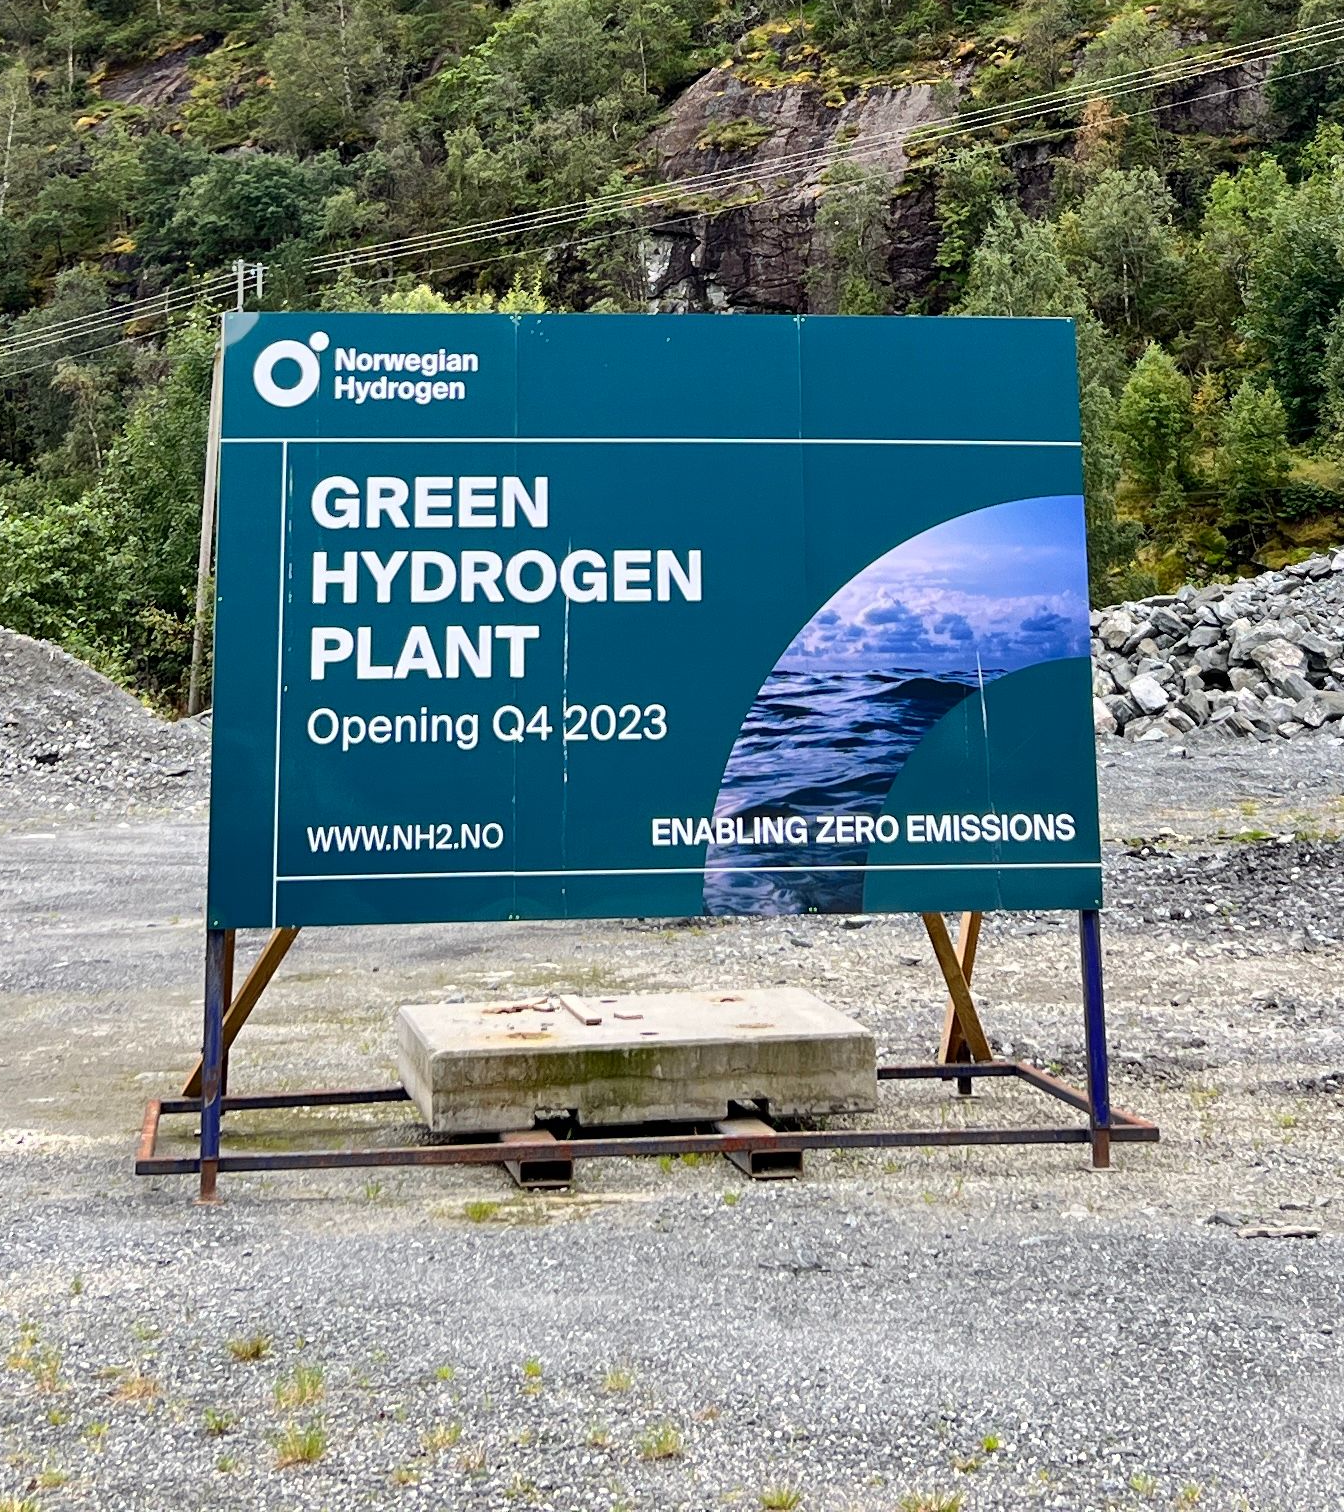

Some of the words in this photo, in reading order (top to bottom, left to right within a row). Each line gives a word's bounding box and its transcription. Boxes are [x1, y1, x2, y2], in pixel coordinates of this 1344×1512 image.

[334, 347, 479, 375] Norwegian
[334, 376, 465, 405] Hydrogen
[311, 475, 548, 529] GREEN
[312, 549, 702, 604] HYDROGEN
[310, 625, 540, 680] PLANT
[307, 706, 479, 752] Opening
[492, 705, 553, 743] Q4
[565, 705, 667, 741] 2023
[306, 822, 504, 852] WWW.NH2.NO
[652, 817, 808, 846] ENABLING
[815, 814, 899, 844] ZERO
[906, 813, 1076, 842] EMISSIONS
